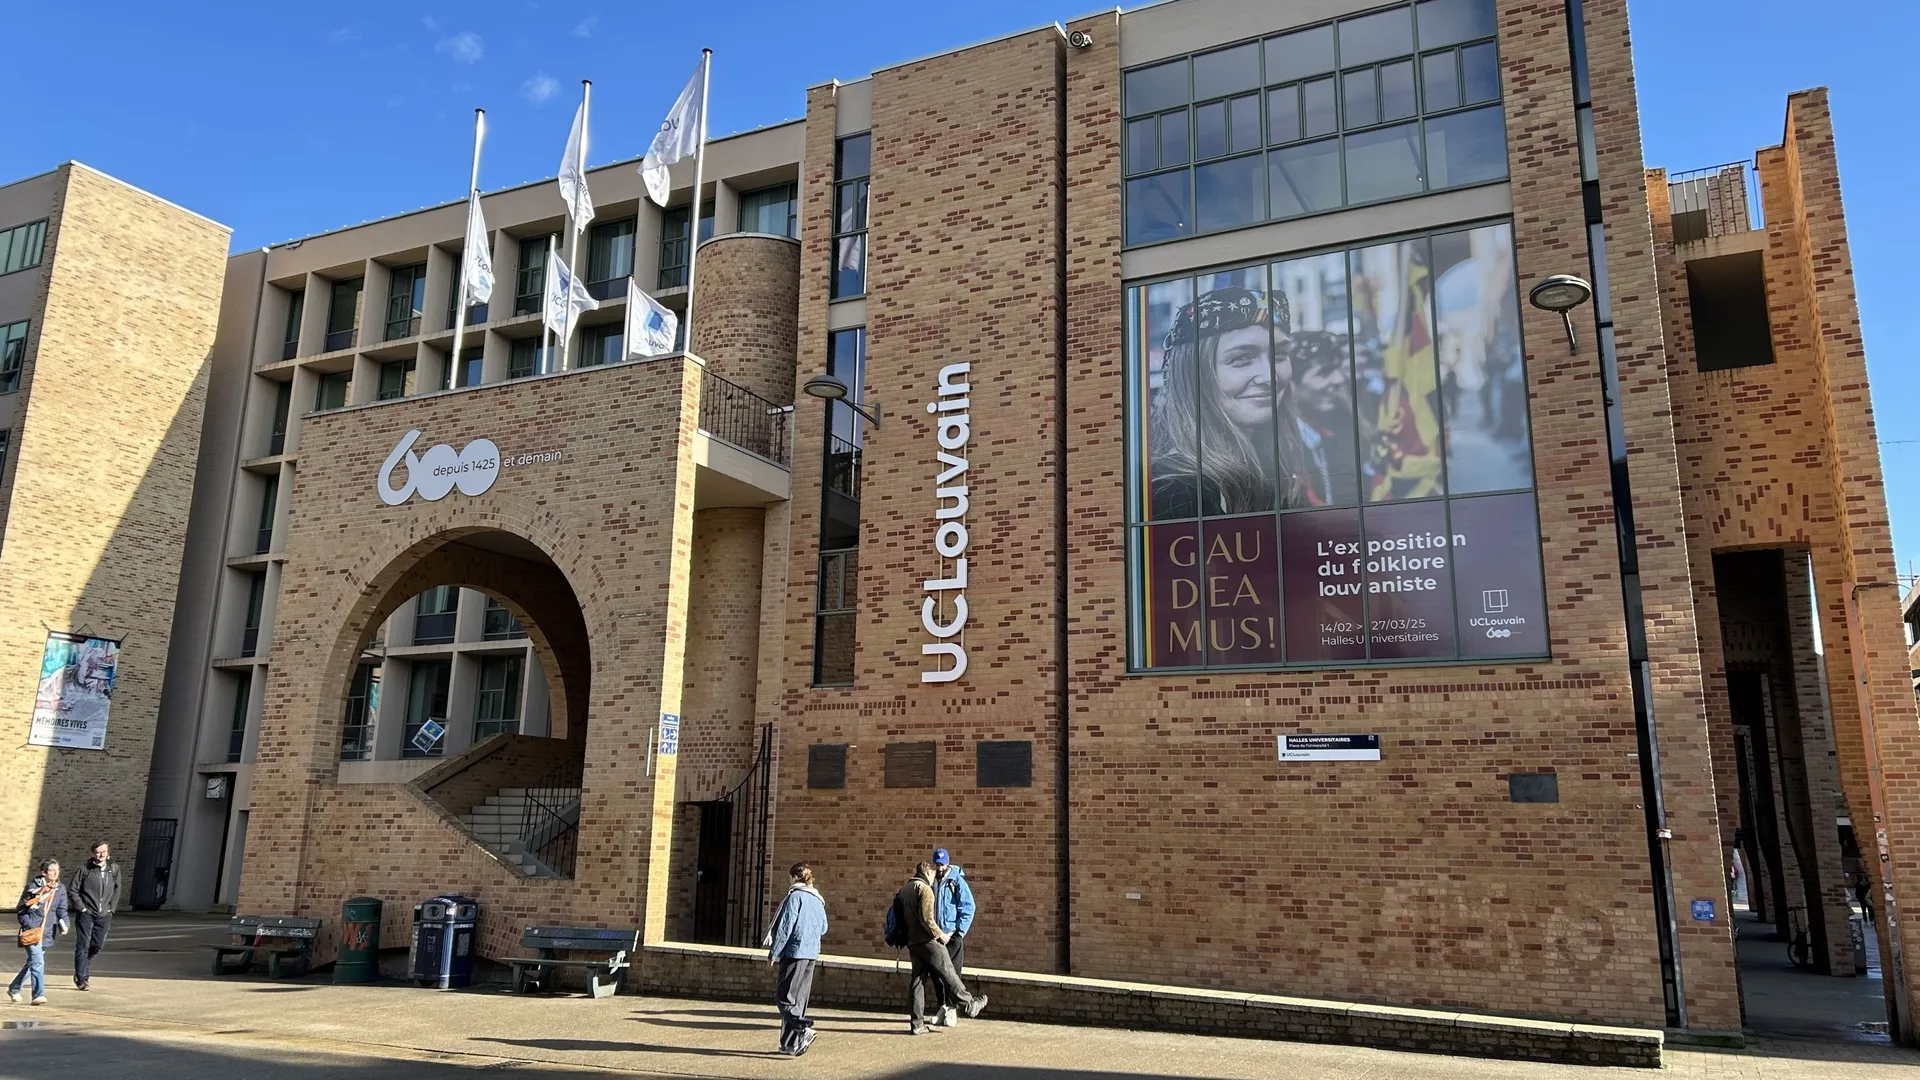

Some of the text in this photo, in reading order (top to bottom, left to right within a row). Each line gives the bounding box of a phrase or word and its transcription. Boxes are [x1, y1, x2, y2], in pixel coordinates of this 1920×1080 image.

[433, 450, 562, 477] depuis 1425 et demain
[921, 361, 971, 683] UCLouvain
[1169, 530, 1260, 567] GAU
[1318, 555, 1445, 576] du folklore
[1171, 574, 1261, 609] DEA
[1319, 576, 1437, 597] louvaniste
[1320, 622, 1352, 634] 14/02
[1371, 619, 1426, 631] 27/03/25
[1470, 616, 1525, 628] UCLouvain
[1169, 617, 1276, 653] MUS!
[1321, 632, 1439, 646] Halles Universitaires
[70, 719, 88, 729] VIVES
